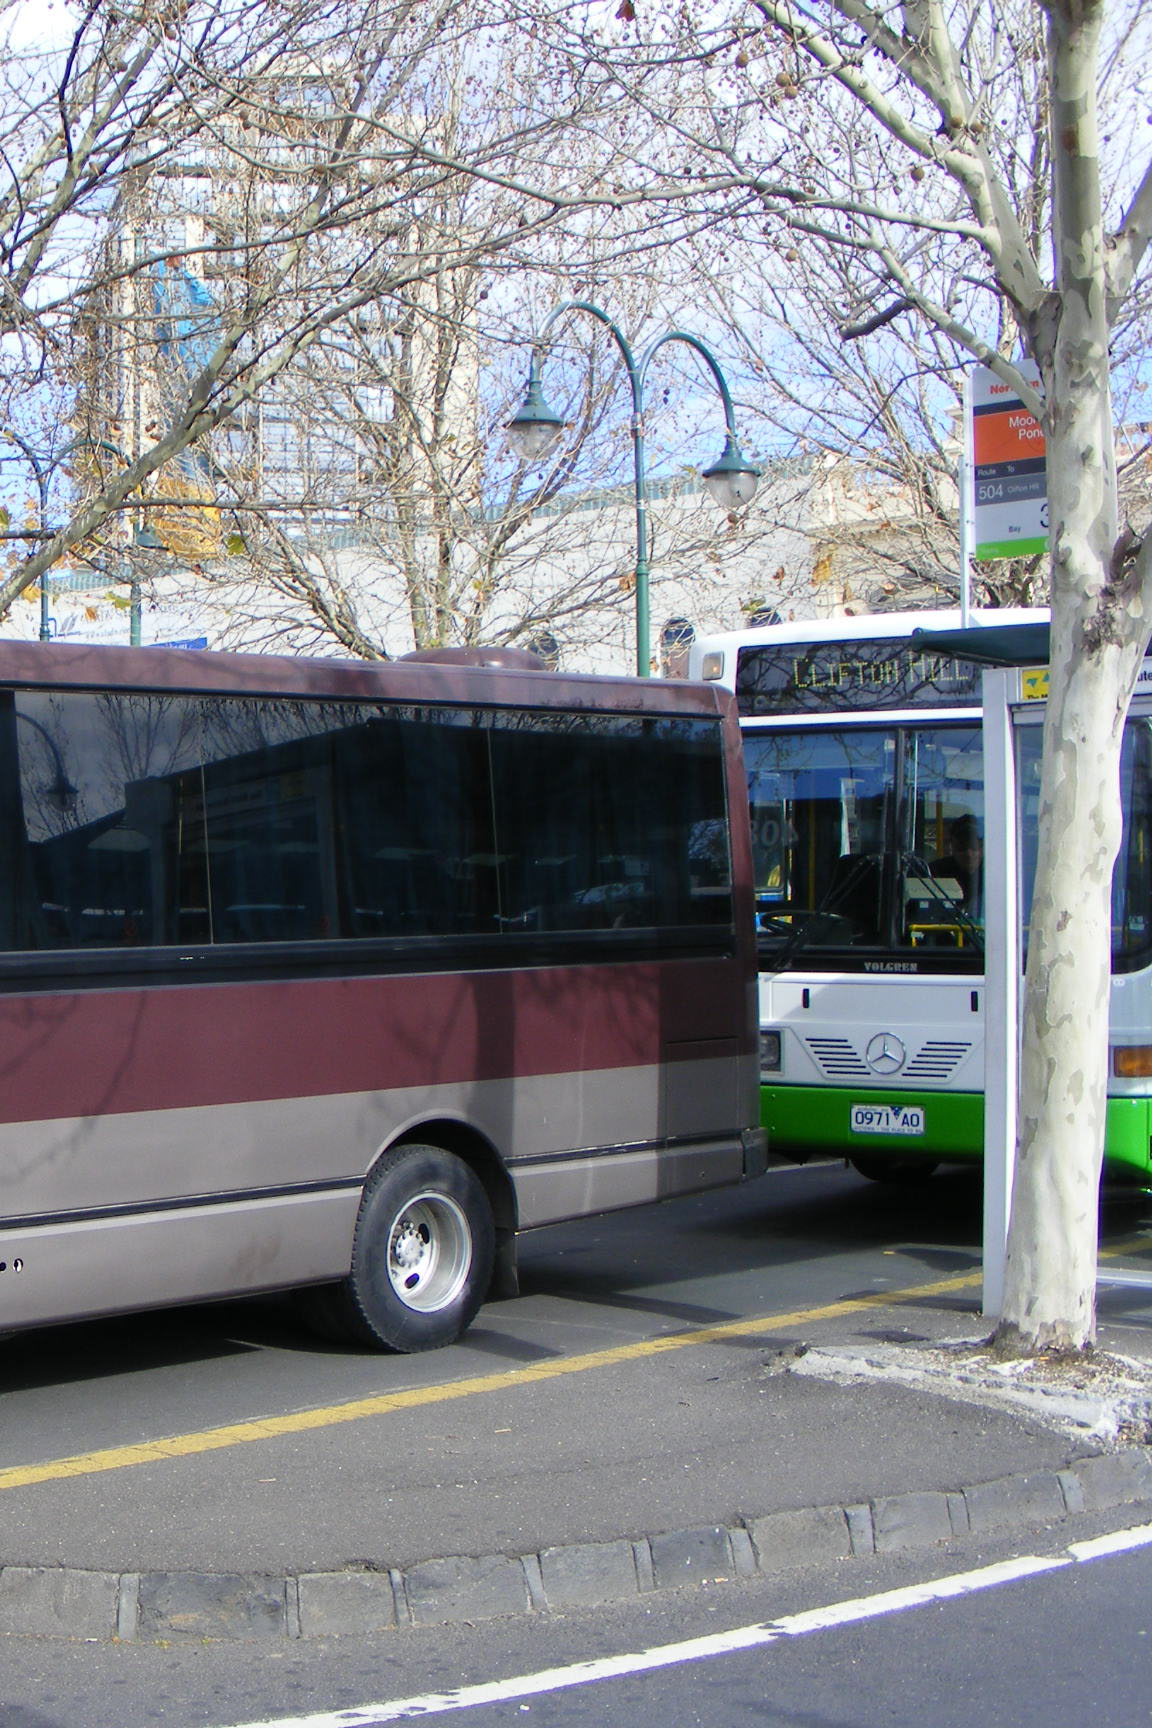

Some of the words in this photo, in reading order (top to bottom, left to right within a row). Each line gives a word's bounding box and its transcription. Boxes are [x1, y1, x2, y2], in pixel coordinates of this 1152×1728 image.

[978, 484, 1004, 500] 504
[792, 656, 899, 688] CLIFTON
[908, 650, 970, 683] HILL
[863, 961, 919, 973] VOLGREN
[854, 1110, 890, 1127] 0971
